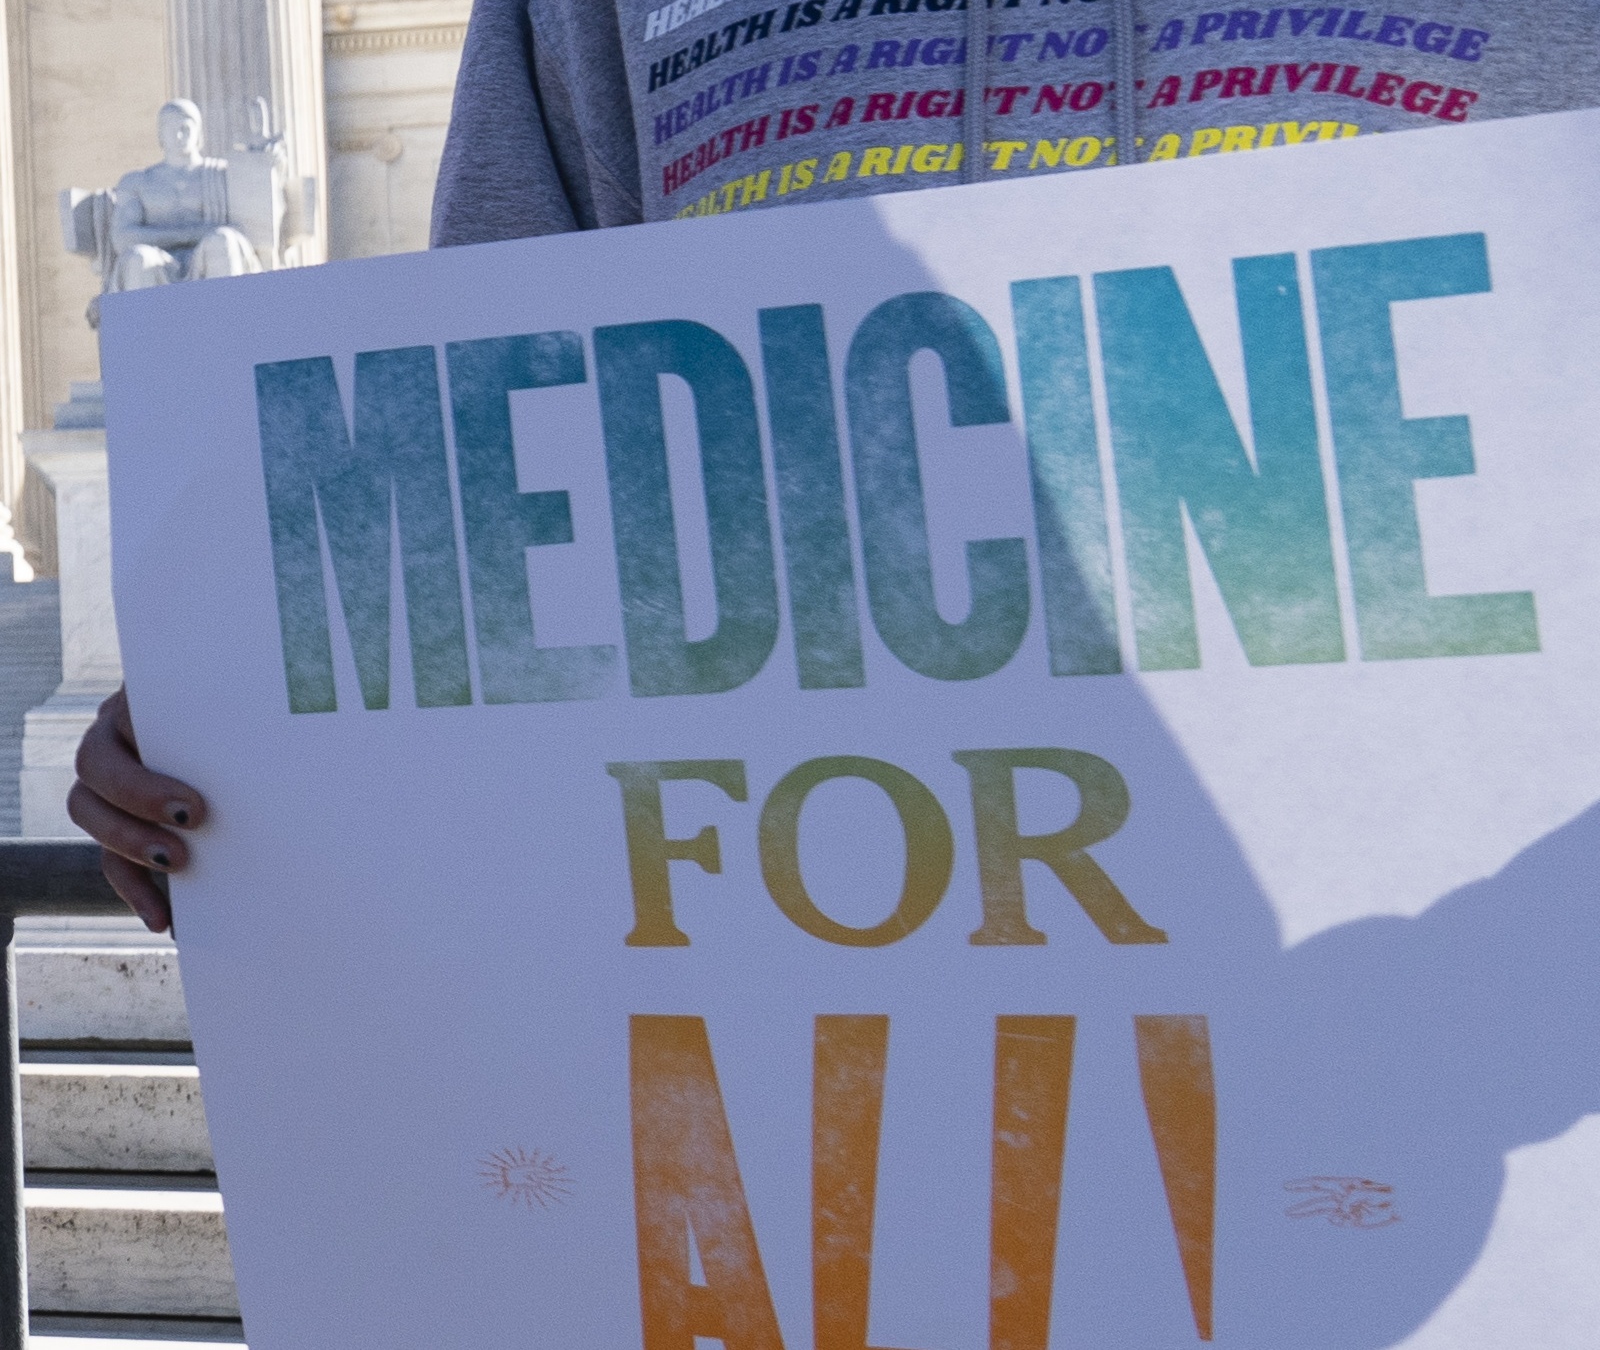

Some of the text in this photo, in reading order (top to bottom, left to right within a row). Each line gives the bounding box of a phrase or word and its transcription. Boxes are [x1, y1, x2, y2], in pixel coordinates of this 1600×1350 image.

[648, 8, 778, 94] HEALTH
[654, 61, 772, 146] HEALTH
[776, 50, 823, 87] IS
[826, 43, 860, 77] A
[1037, 24, 1148, 62] NO
[1151, 18, 1186, 51] A
[1189, 7, 1491, 62] PRIVILEGE
[662, 114, 771, 196] HEALTH
[775, 103, 821, 141] IS
[822, 96, 856, 129] A
[1146, 75, 1182, 109] A
[1186, 62, 1479, 123] PRIVILEGE
[776, 158, 819, 196] IS
[822, 150, 853, 184] A
[1148, 133, 1181, 163] A
[253, 232, 1542, 715] MEDICINE
[606, 745, 1169, 948] FOR
